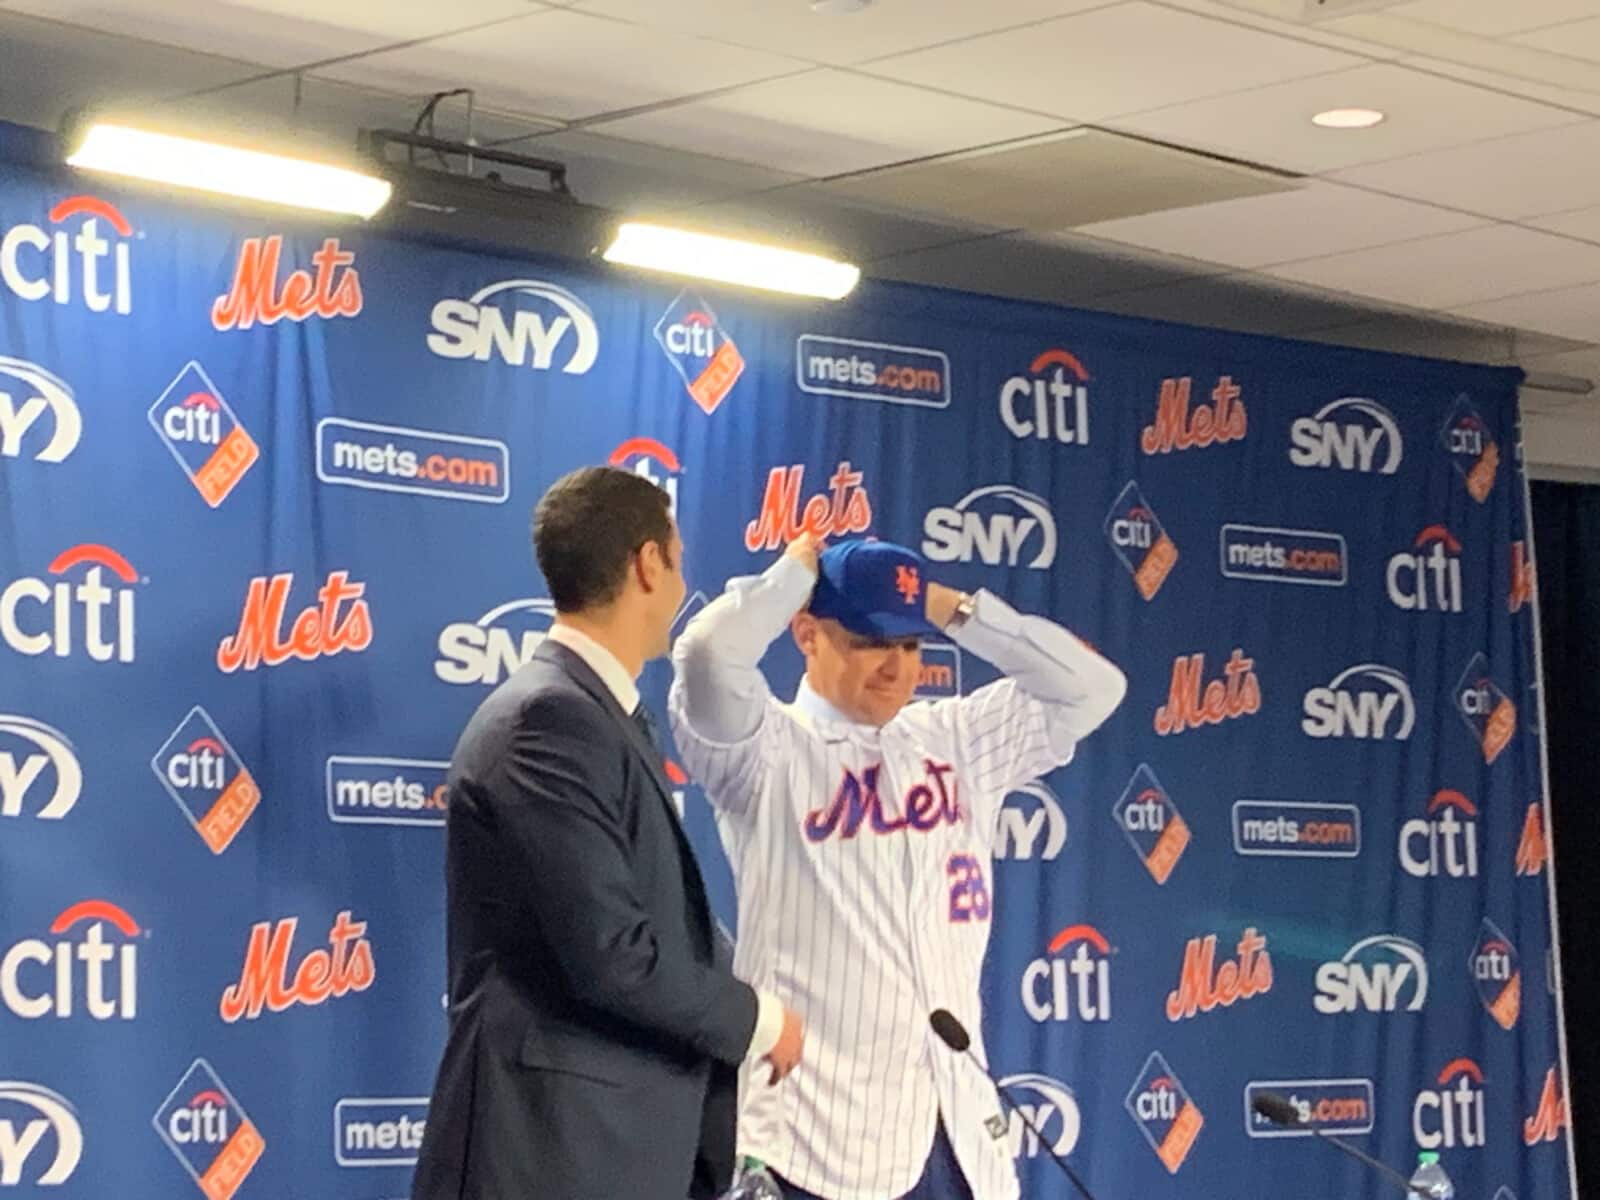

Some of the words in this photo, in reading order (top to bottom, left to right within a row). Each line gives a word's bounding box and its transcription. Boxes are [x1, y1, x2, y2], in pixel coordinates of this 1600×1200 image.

[0, 218, 132, 314] citi
[211, 235, 363, 331] Mets
[427, 298, 571, 370] SNY
[665, 320, 715, 358] citi
[808, 355, 941, 393] mets.com
[1000, 367, 1089, 445] citi
[163, 402, 220, 444] citi
[1141, 376, 1248, 454] Mets
[1289, 417, 1384, 473] SNY
[333, 442, 498, 487] mets.com
[745, 461, 873, 553] Mets
[922, 505, 1038, 567] SNY
[1228, 542, 1340, 572] mets.com
[1386, 542, 1463, 613] citi
[0, 566, 135, 662] citi
[216, 571, 374, 673] Mets
[1154, 649, 1262, 735] Mets
[1302, 687, 1402, 740] SNY
[167, 747, 225, 790] citi
[337, 776, 449, 810] mets.c
[804, 757, 965, 844] Met
[1243, 816, 1353, 844] mets.com
[1399, 807, 1479, 877] citi
[0, 922, 136, 1019] citi
[219, 911, 376, 1023] Mets
[1022, 943, 1110, 1022] citi
[1166, 927, 1274, 1022] Mets
[1313, 961, 1413, 1014] SNY
[169, 1101, 227, 1143] citi
[1136, 1085, 1176, 1121] citi
[1413, 1076, 1485, 1148] citi
